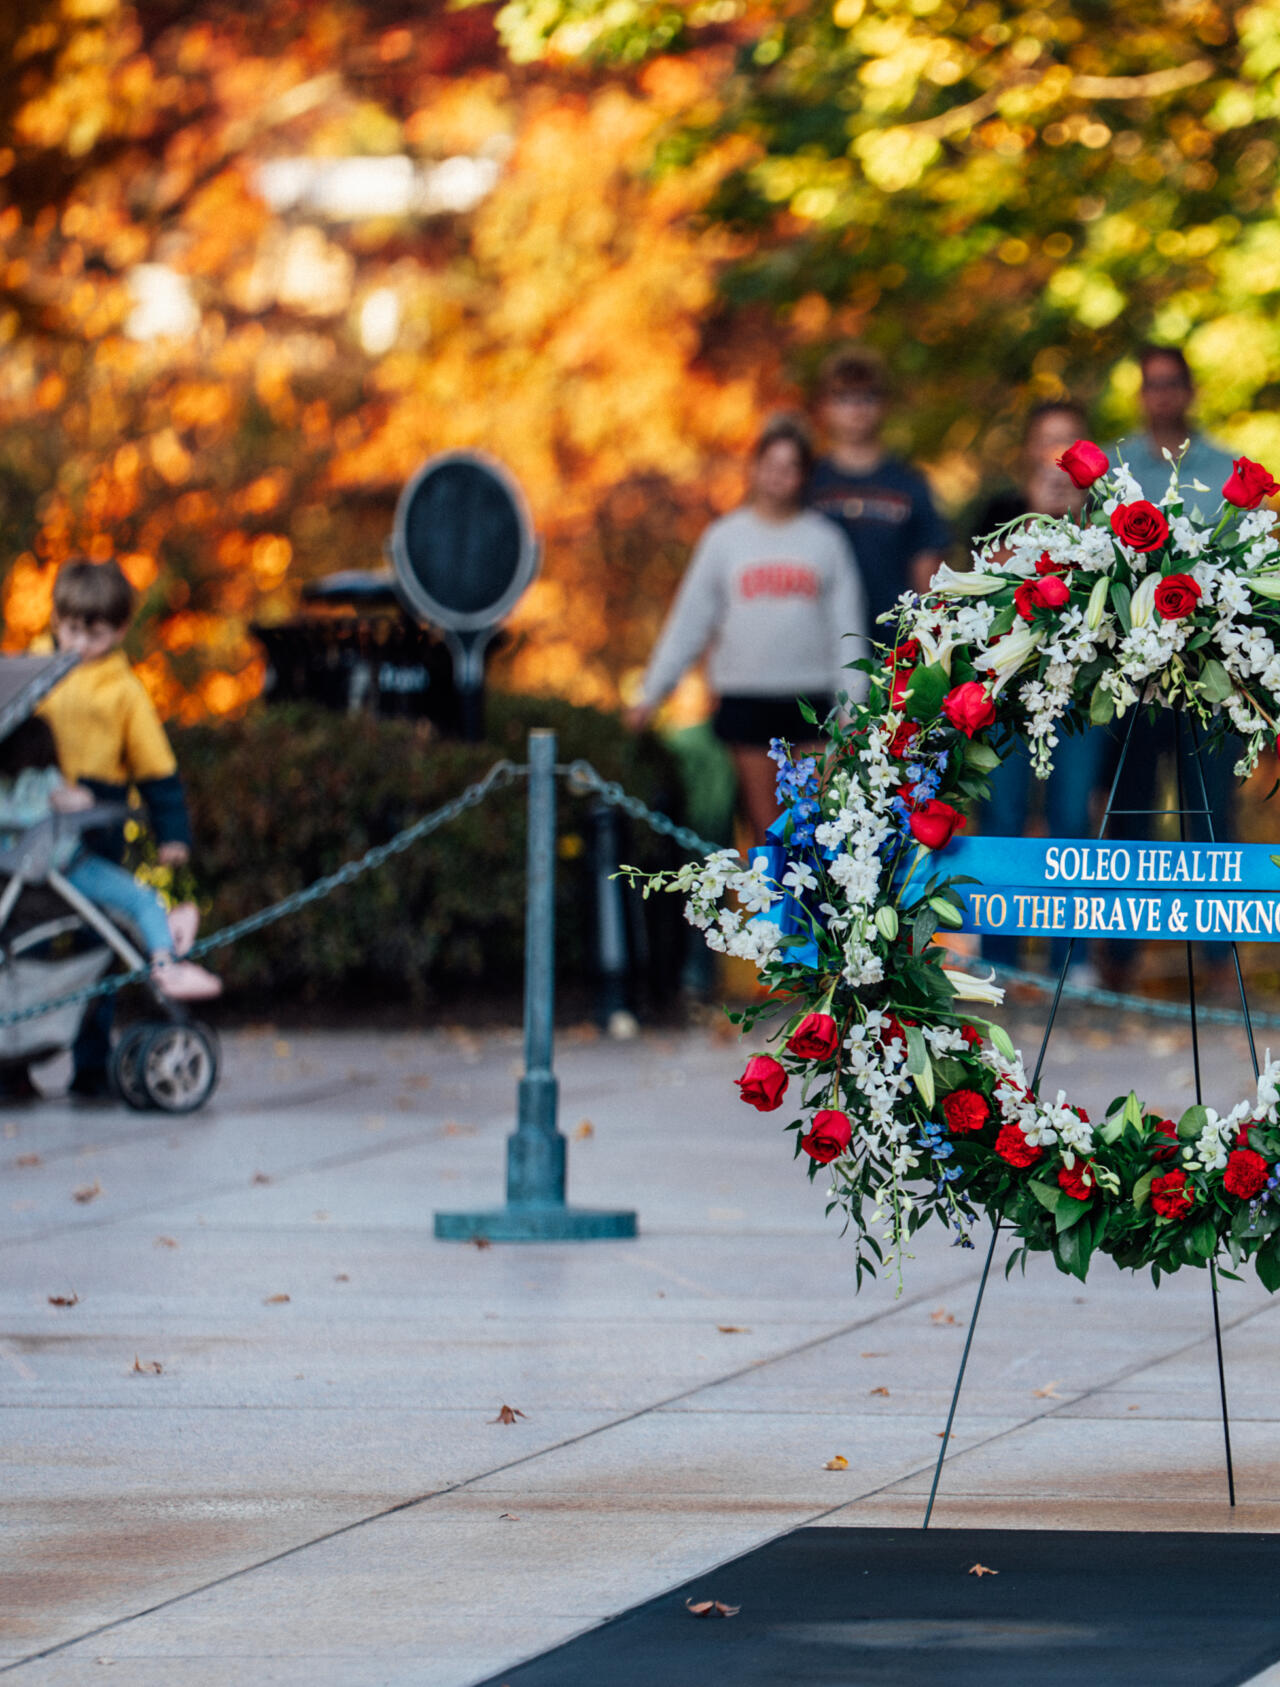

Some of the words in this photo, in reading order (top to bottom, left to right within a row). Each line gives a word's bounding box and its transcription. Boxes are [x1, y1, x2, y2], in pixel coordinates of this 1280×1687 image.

[1044, 846, 1131, 882] SOLEO
[1136, 849, 1243, 882] HEALTH
[969, 893, 1007, 928] TO
[1013, 895, 1067, 929] THE
[1073, 896, 1162, 932] BRAVE
[1167, 898, 1189, 933] &
